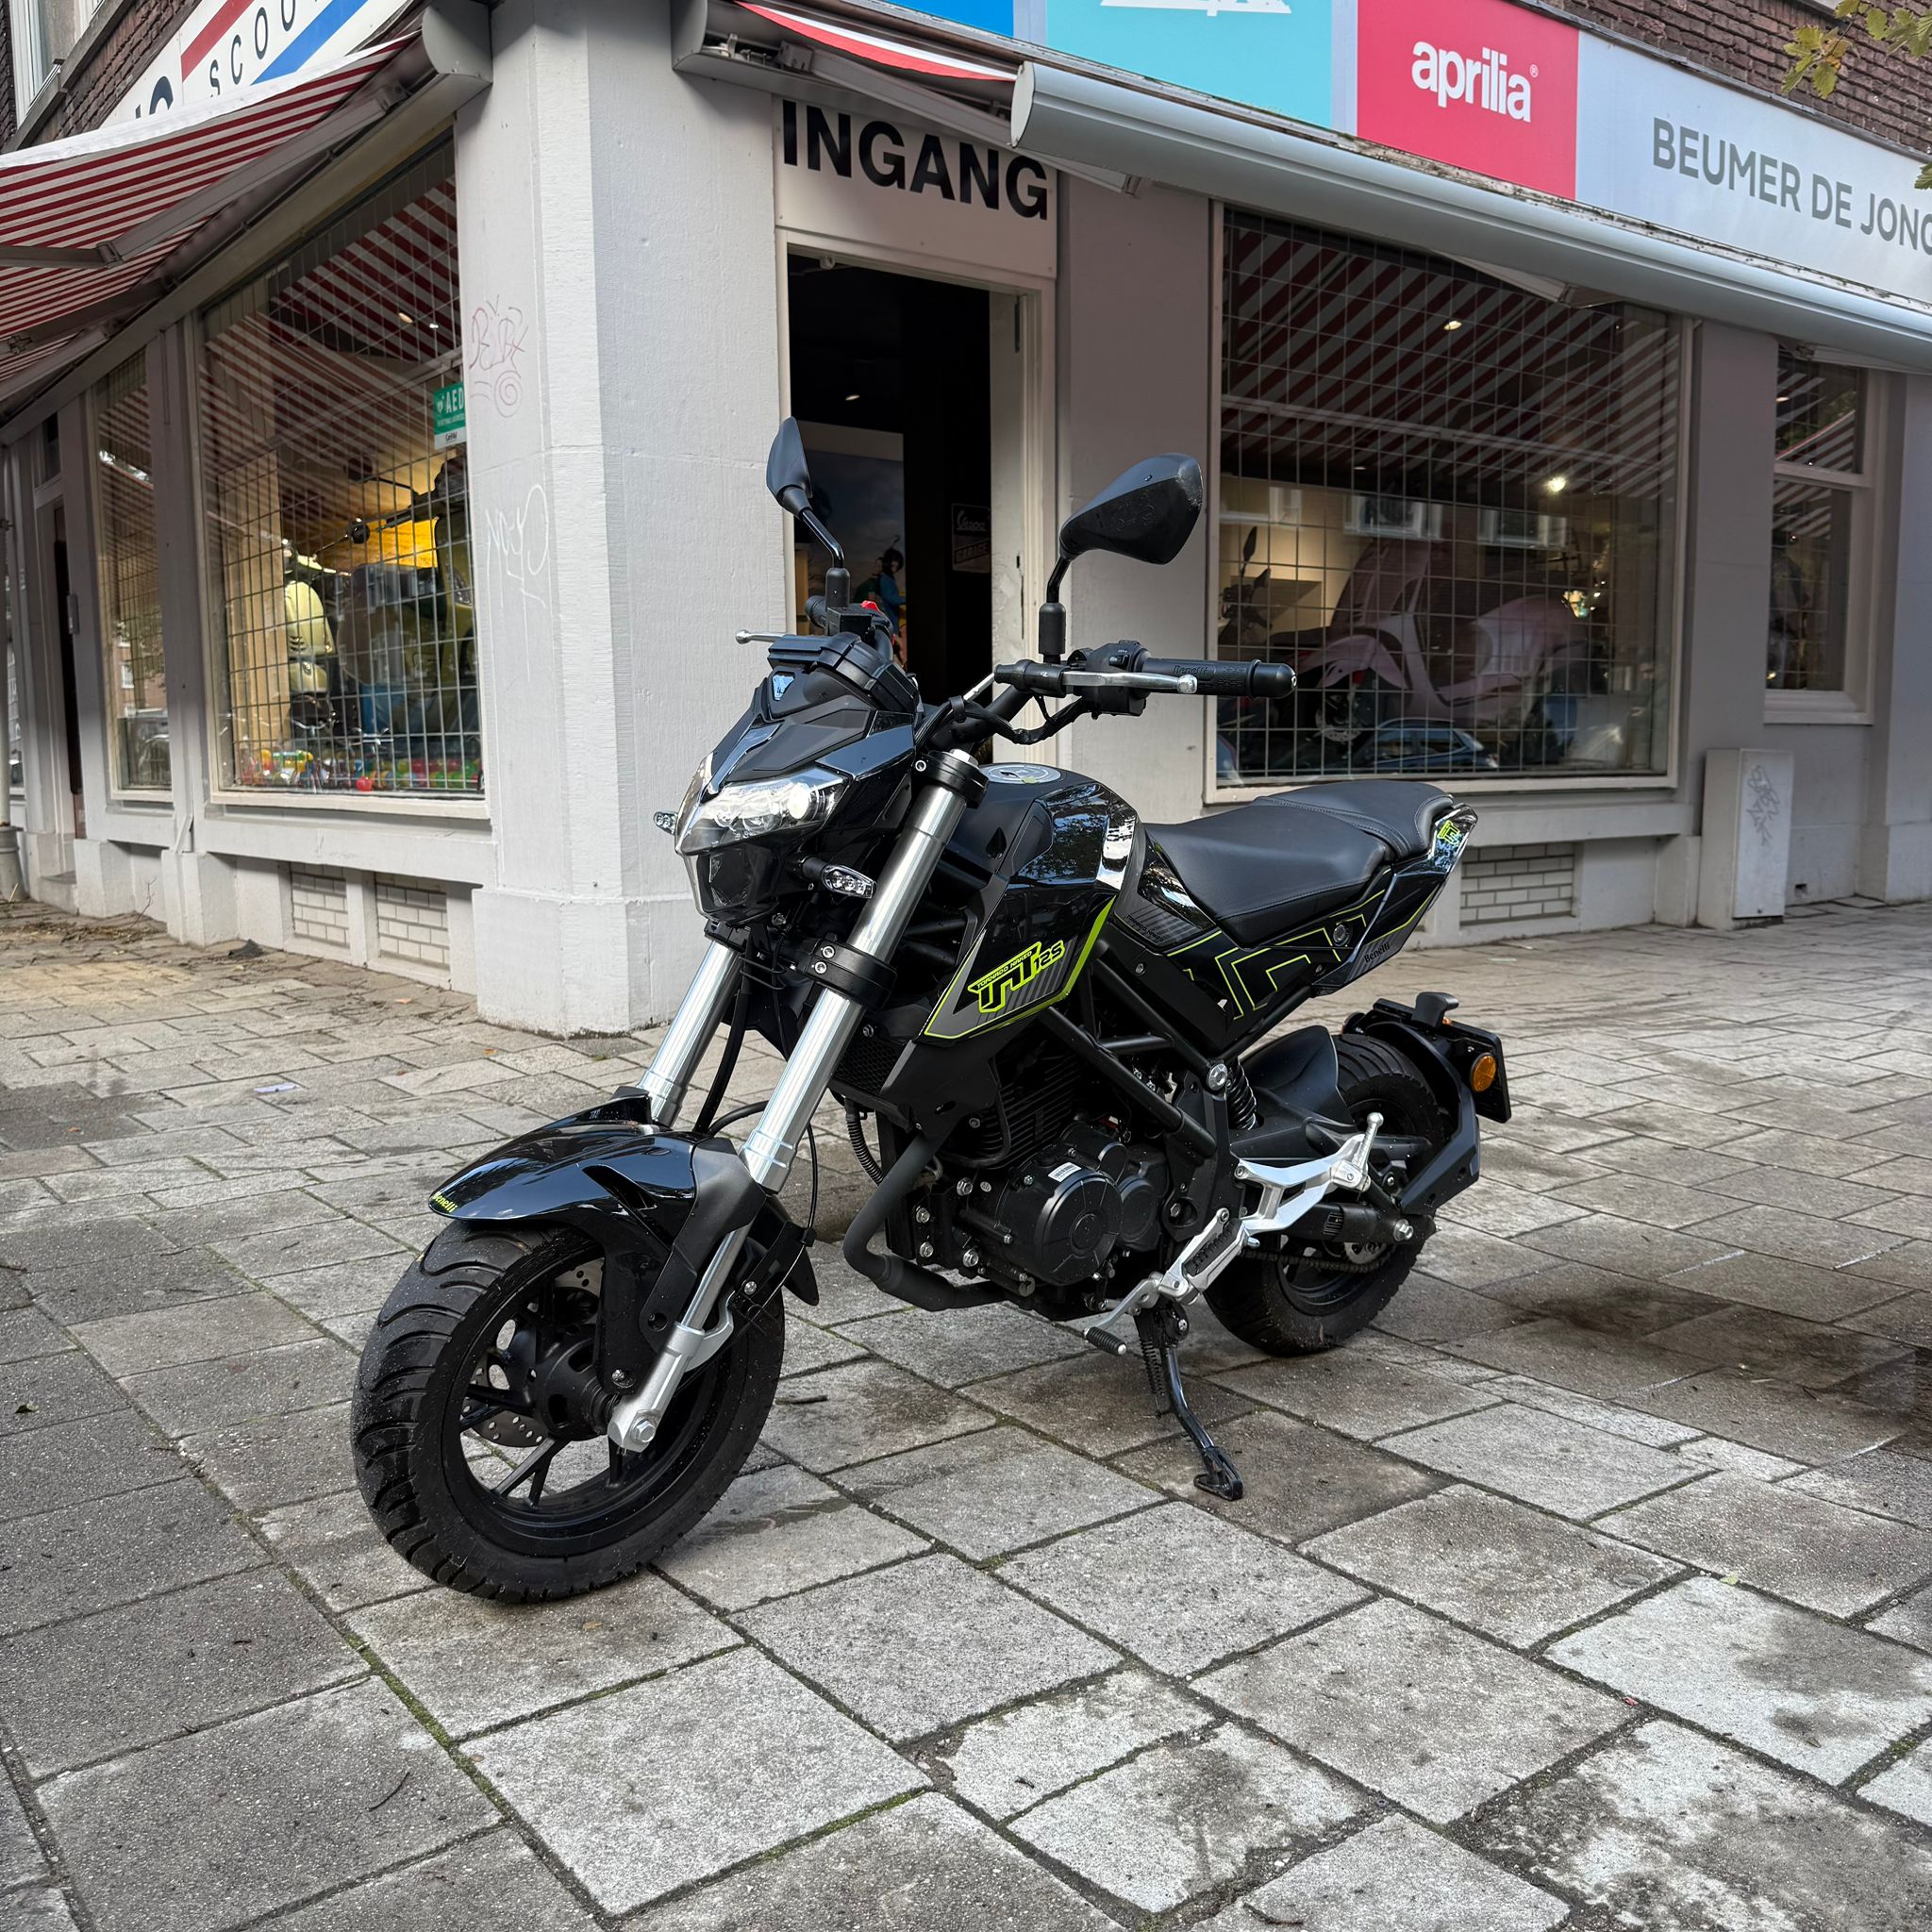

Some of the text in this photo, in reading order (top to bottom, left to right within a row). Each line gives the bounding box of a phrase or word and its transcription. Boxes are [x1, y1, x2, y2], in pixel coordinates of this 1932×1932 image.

[209, 0, 318, 97] SCOO
[1411, 41, 1531, 123] aprilia
[782, 98, 1048, 221] INGANG
[1653, 117, 1801, 212] BEUMER
[1811, 173, 1853, 228] DE
[446, 387, 464, 414] AED
[976, 950, 1033, 990] TORNADO NAKED
[1363, 942, 1391, 963] Benelli
